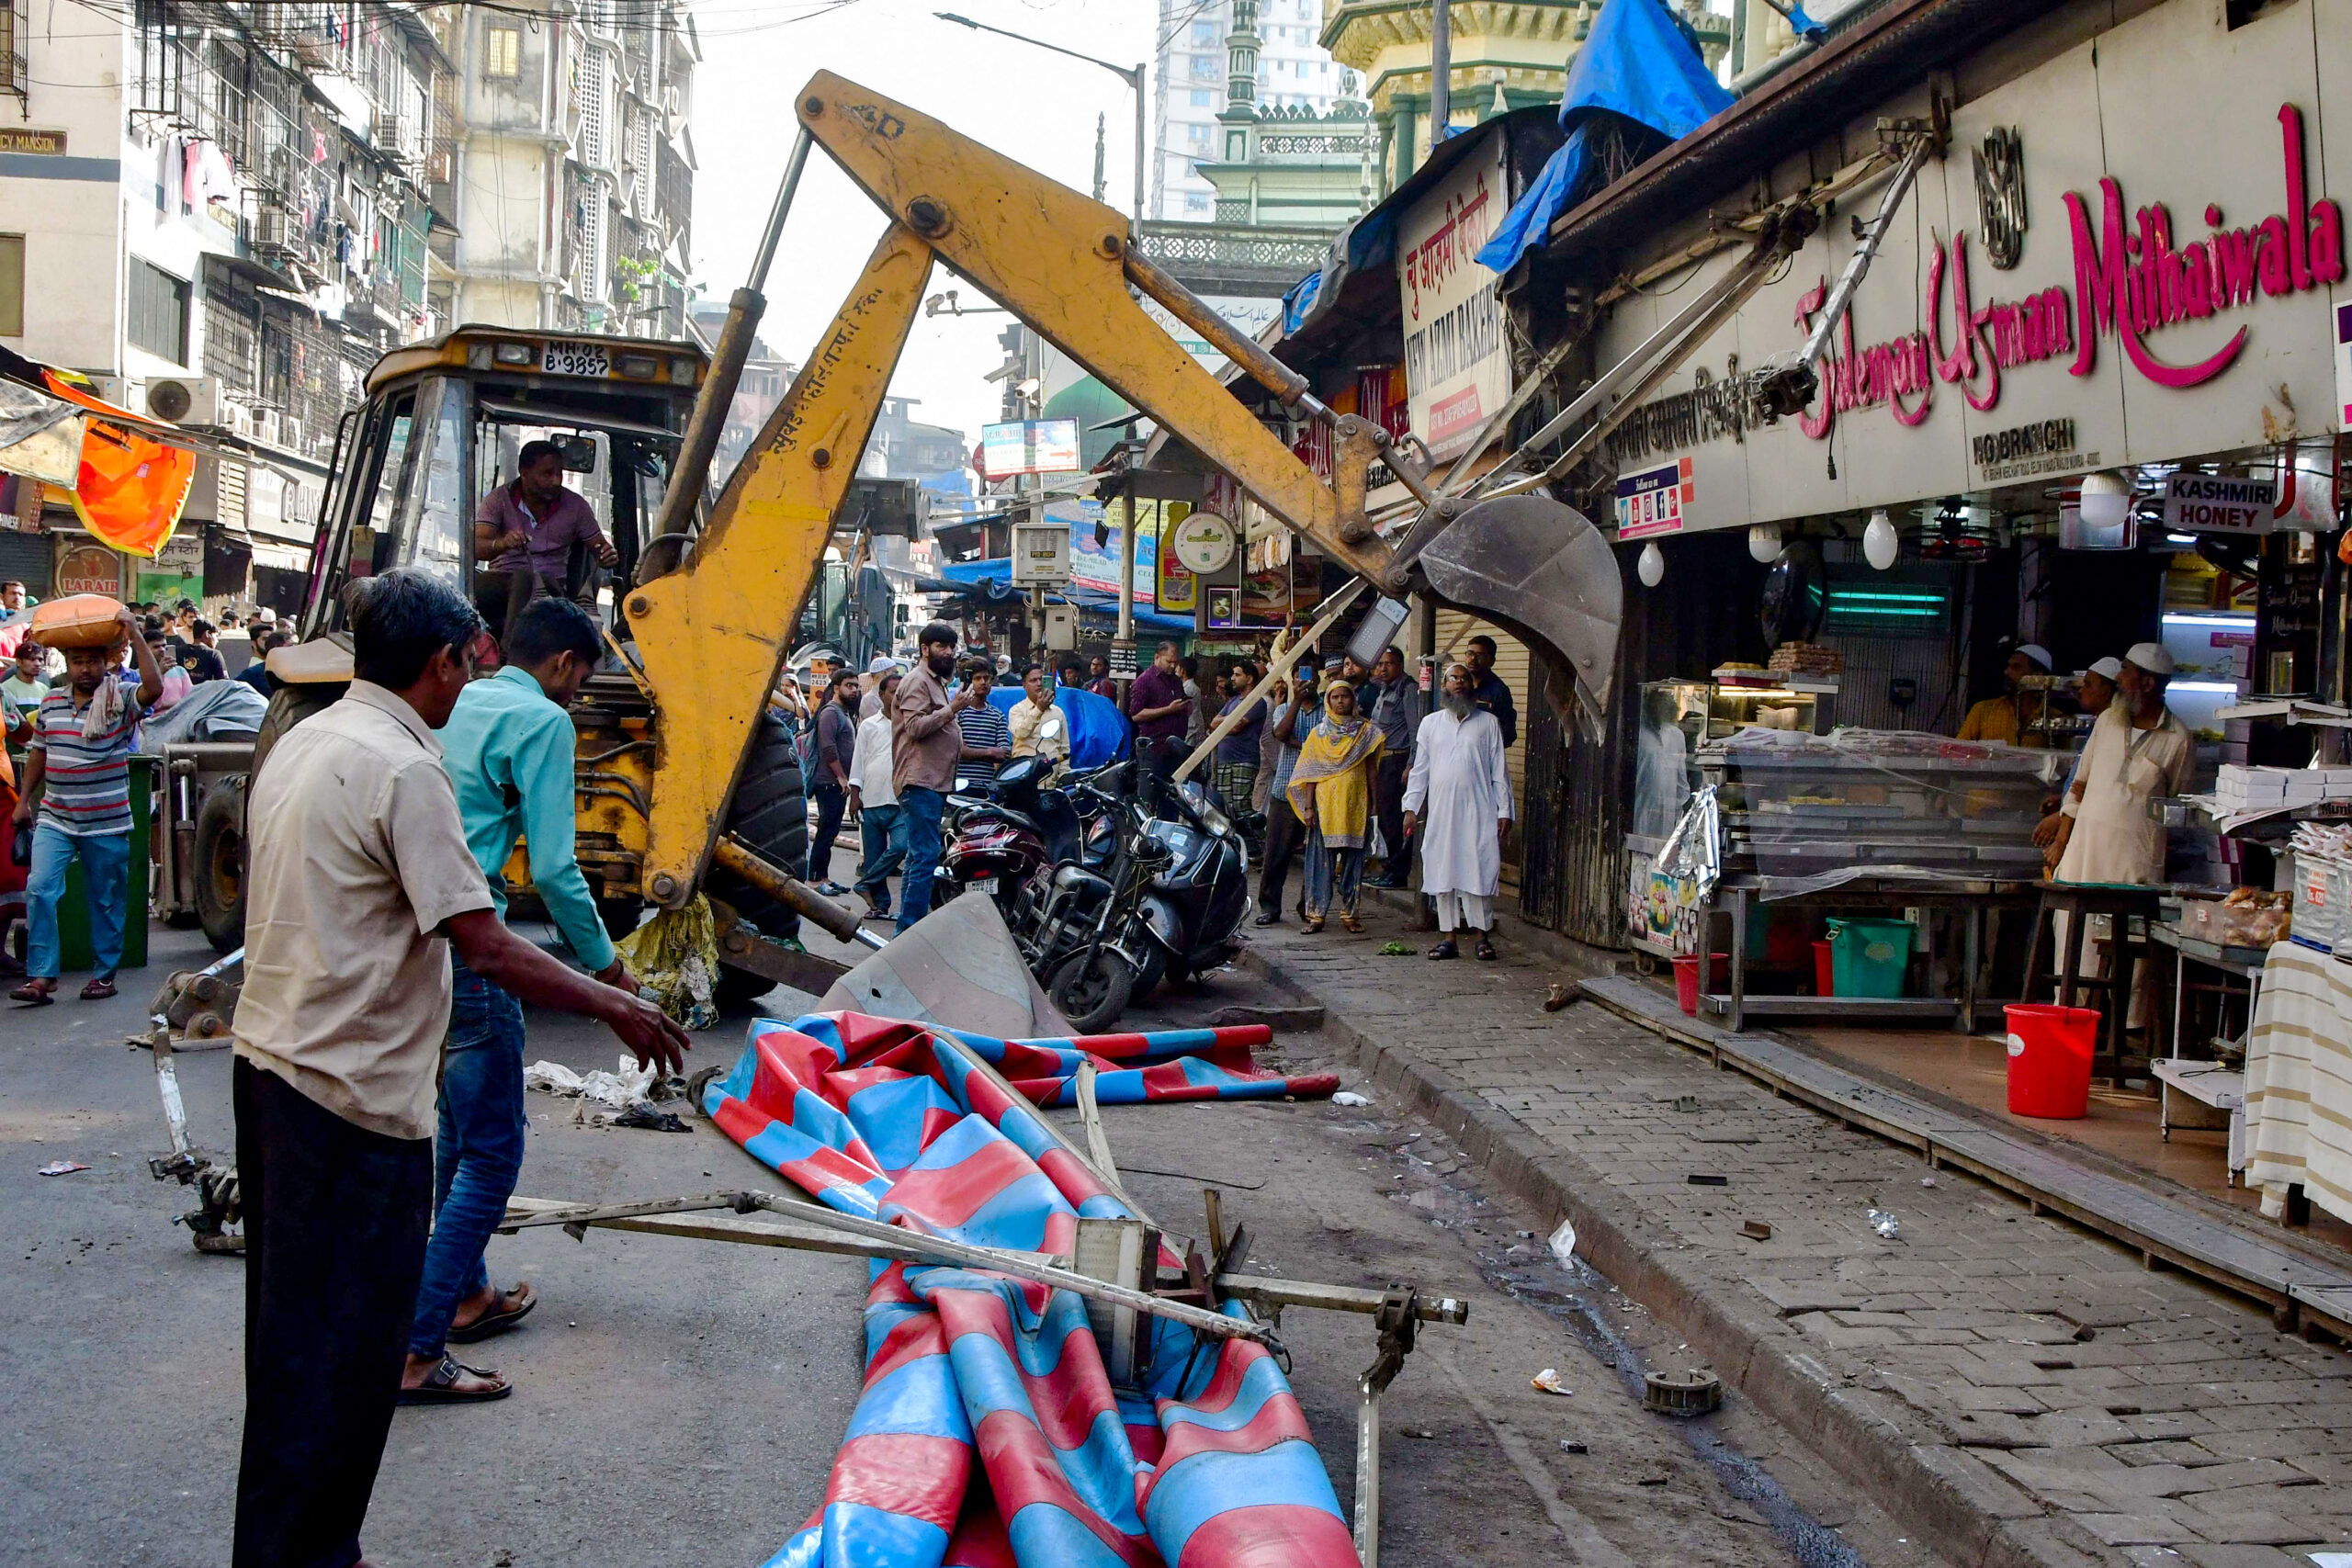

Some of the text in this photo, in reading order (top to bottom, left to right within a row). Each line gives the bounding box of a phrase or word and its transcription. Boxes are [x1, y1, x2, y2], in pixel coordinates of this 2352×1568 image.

[17, 135, 55, 152] MANSION
[1926, 226, 2073, 411] Usman
[2062, 101, 2344, 388] Mithaiwala
[1406, 327, 1427, 399] NEW
[1430, 309, 1457, 389] AZMI
[2172, 479, 2274, 504] KASHMIRI
[2180, 504, 2258, 528] HONEY
